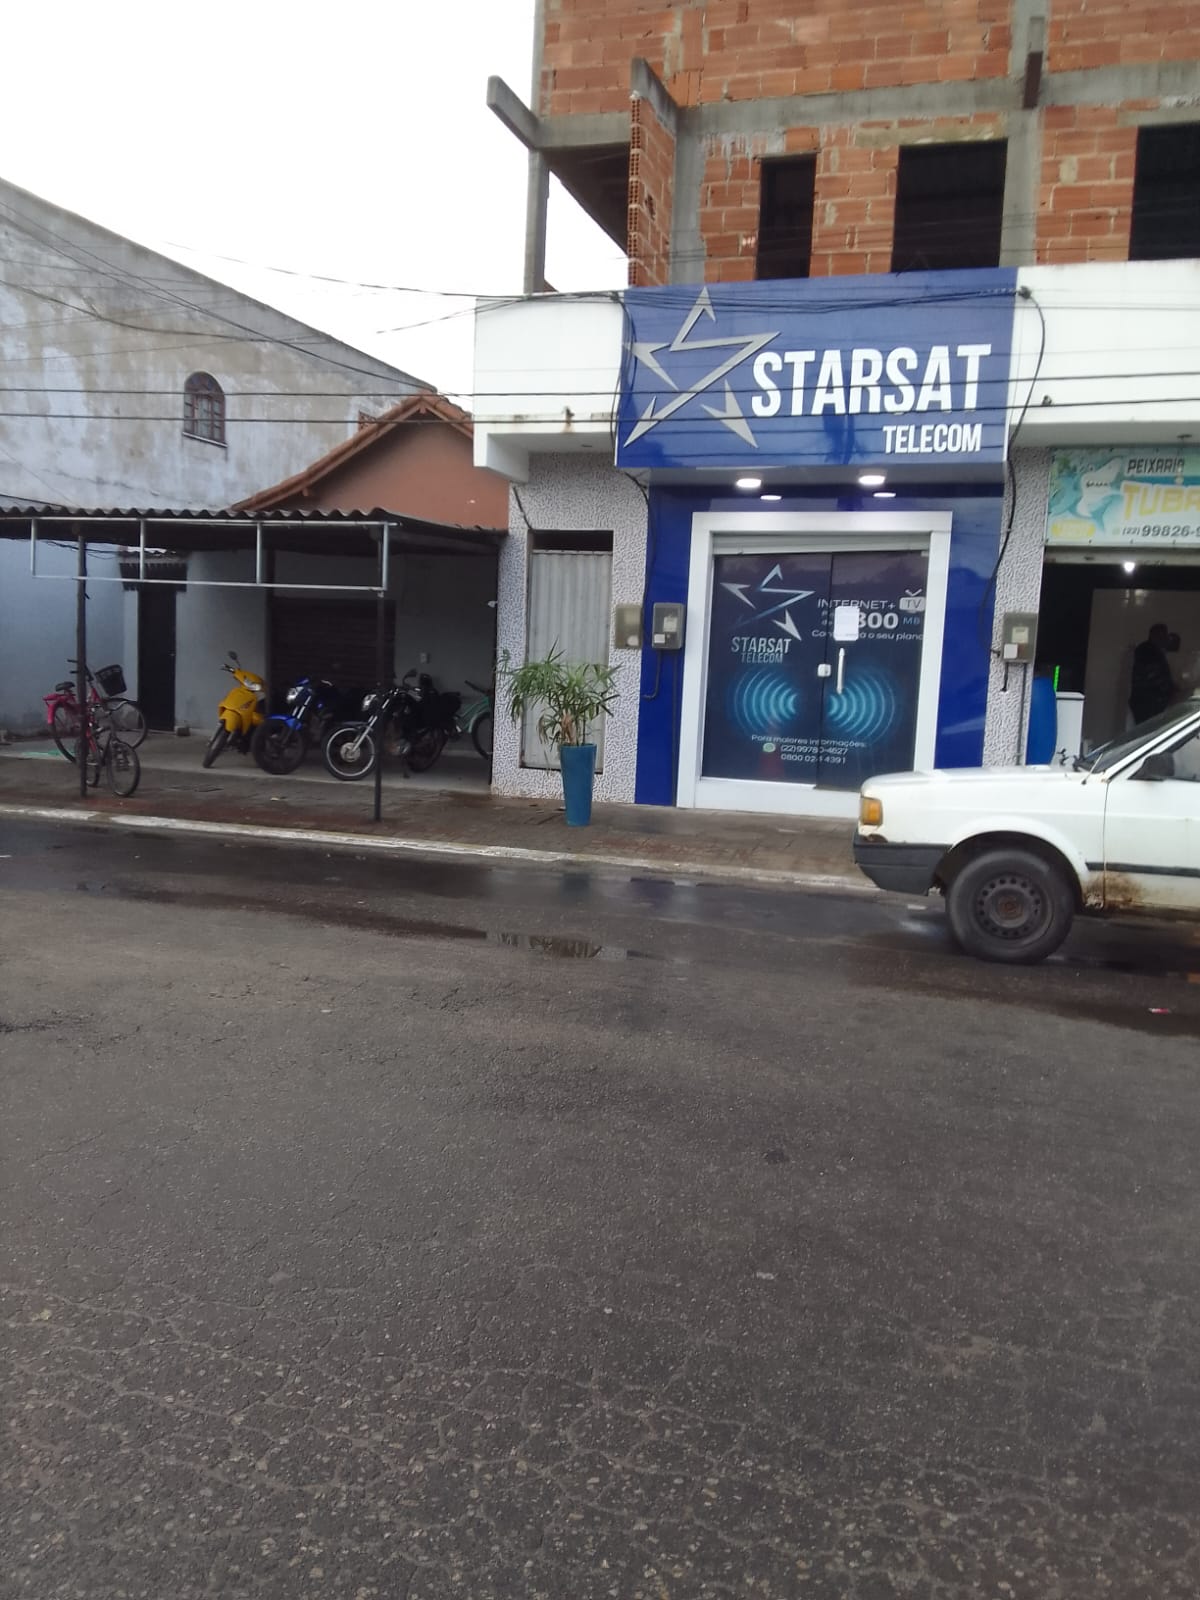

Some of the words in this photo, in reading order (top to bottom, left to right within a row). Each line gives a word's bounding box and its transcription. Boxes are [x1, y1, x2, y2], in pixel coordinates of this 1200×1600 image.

[751, 344, 992, 417] STARSAT
[883, 423, 982, 453] TELECOM
[1127, 458, 1185, 473] PEIXARIA
[731, 637, 792, 654] STARSAT
[741, 652, 783, 663] TELECOM
